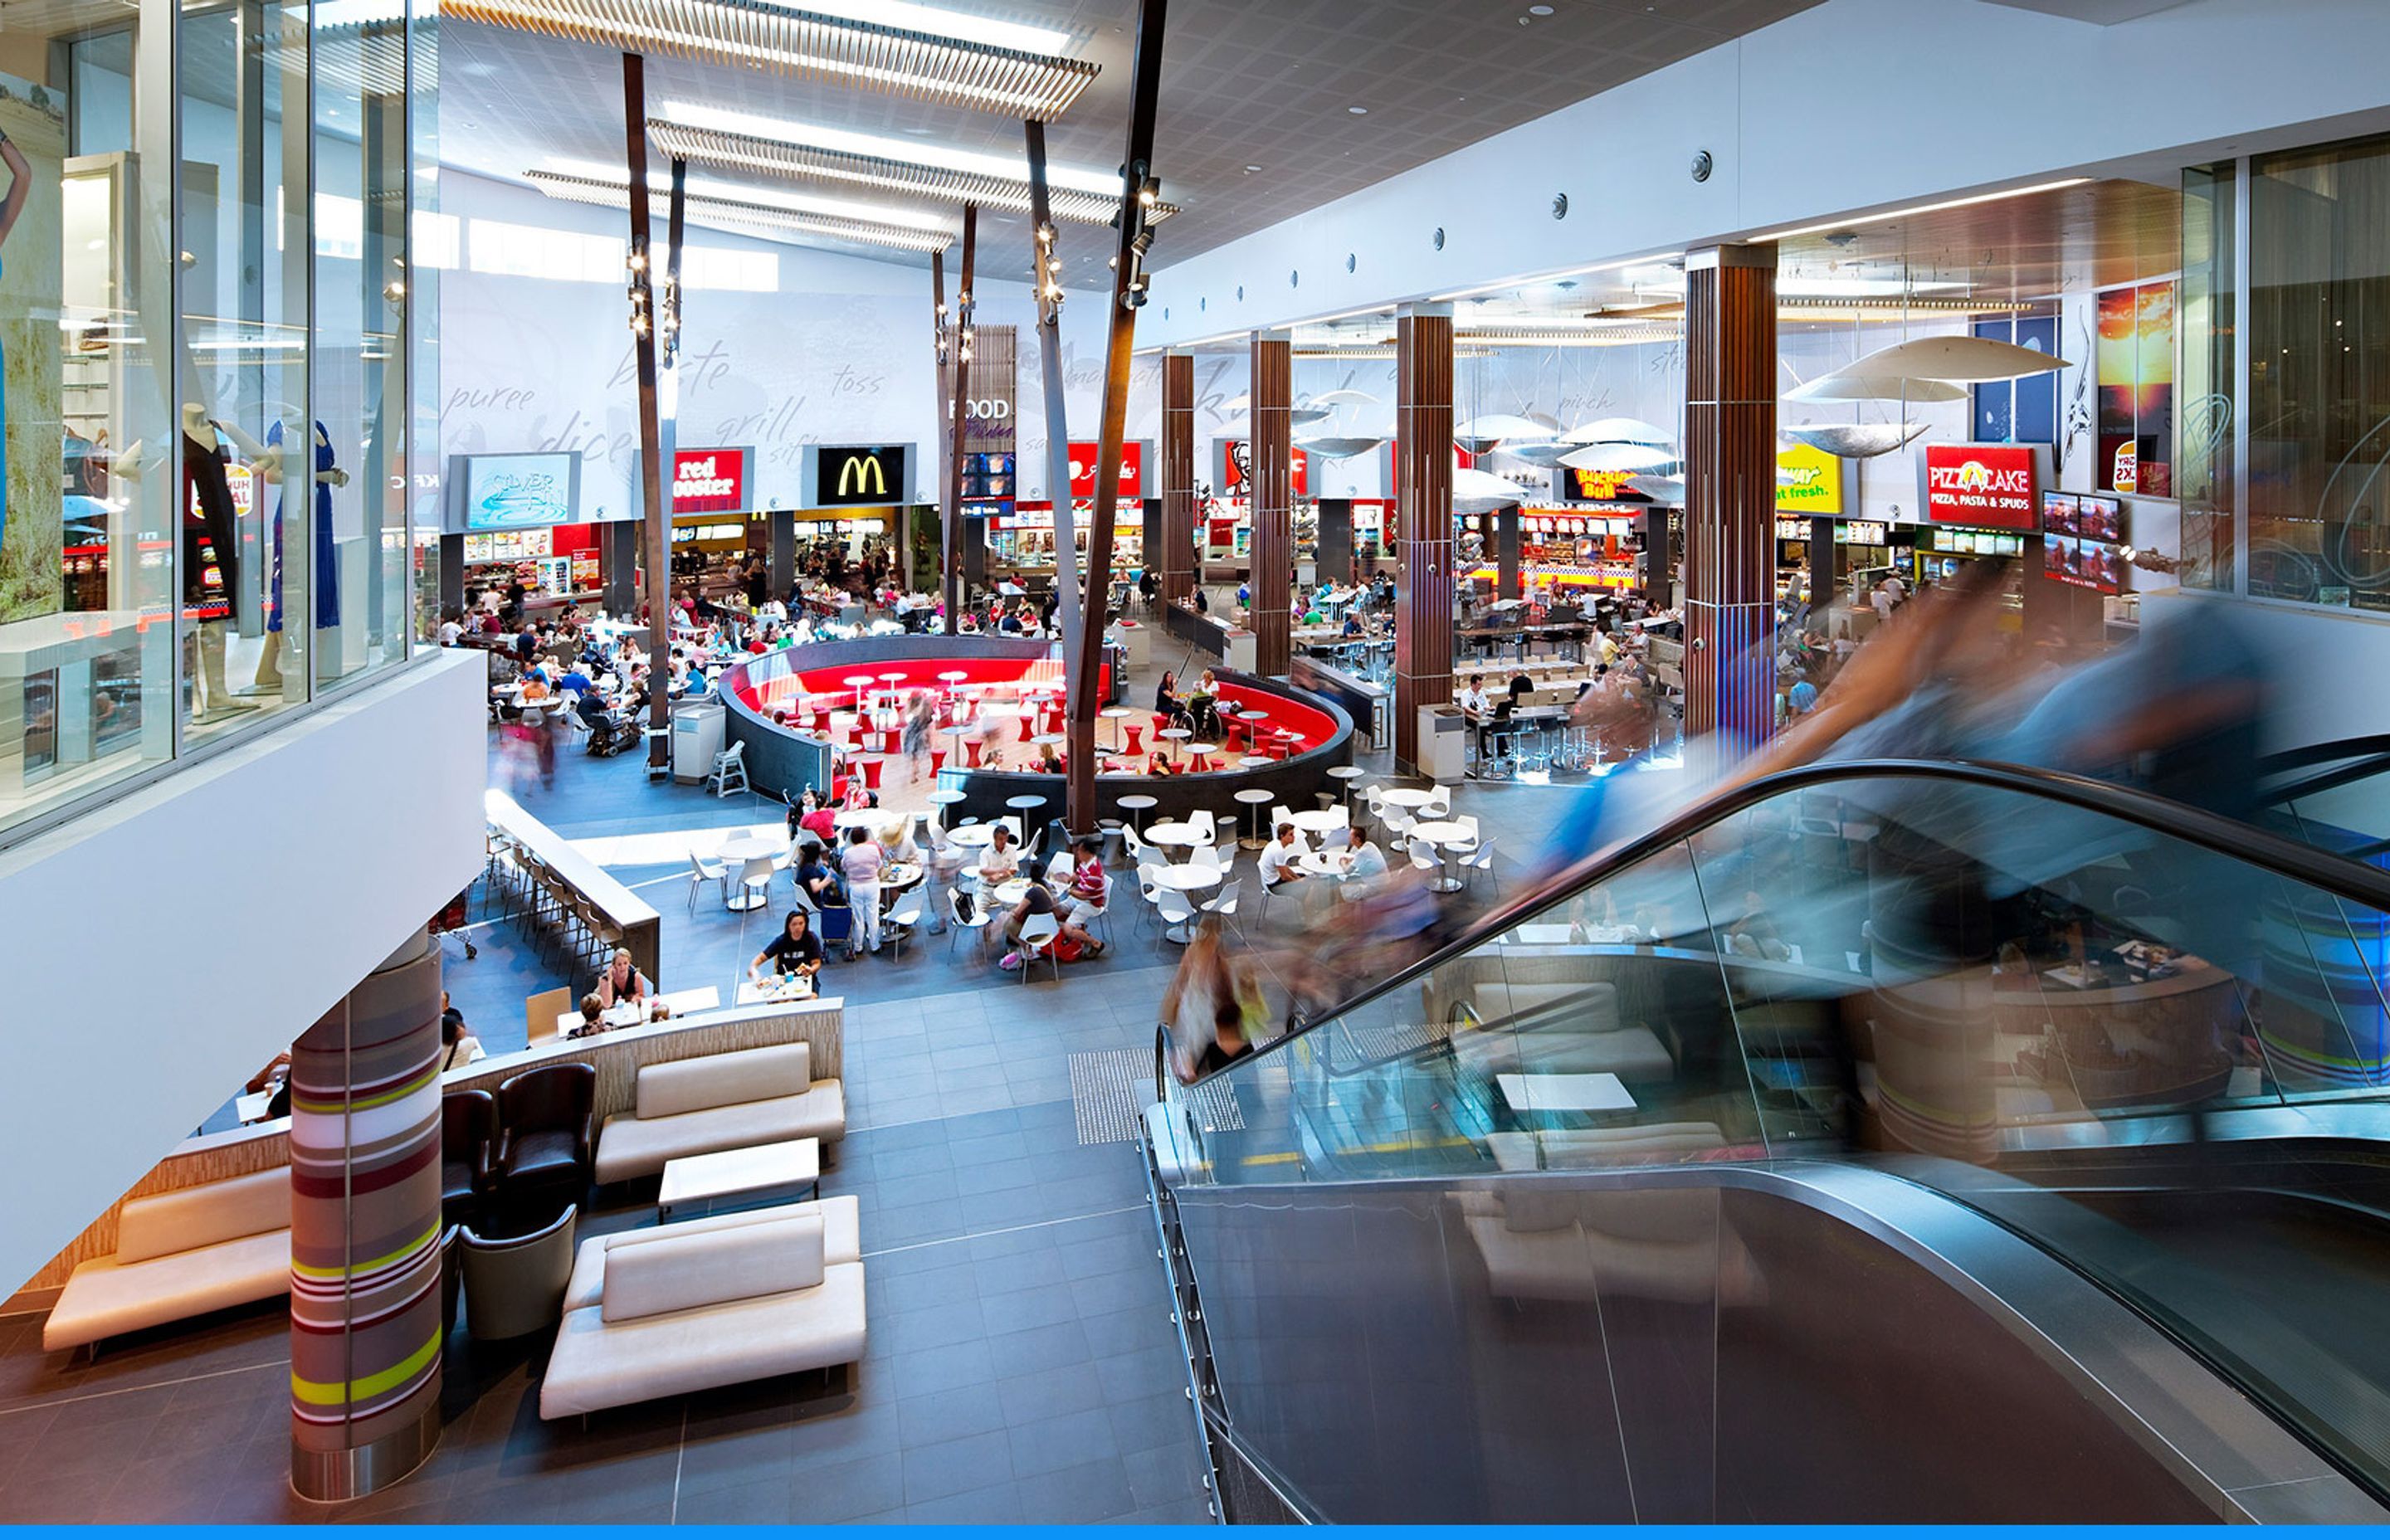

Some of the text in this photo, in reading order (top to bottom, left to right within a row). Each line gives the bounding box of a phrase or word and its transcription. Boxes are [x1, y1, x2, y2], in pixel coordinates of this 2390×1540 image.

[606, 339, 729, 397] bte
[831, 363, 885, 397] toss
[441, 386, 535, 421] puree
[1556, 388, 1618, 417] pinch
[539, 411, 633, 463] dice
[715, 396, 806, 449] grill
[679, 456, 716, 480] red
[673, 477, 734, 498] ooster
[1582, 482, 1617, 500] Bull
[1789, 484, 1829, 499] fresh.
[1930, 493, 2029, 510] PIZZA, PASTA & SPUDS
